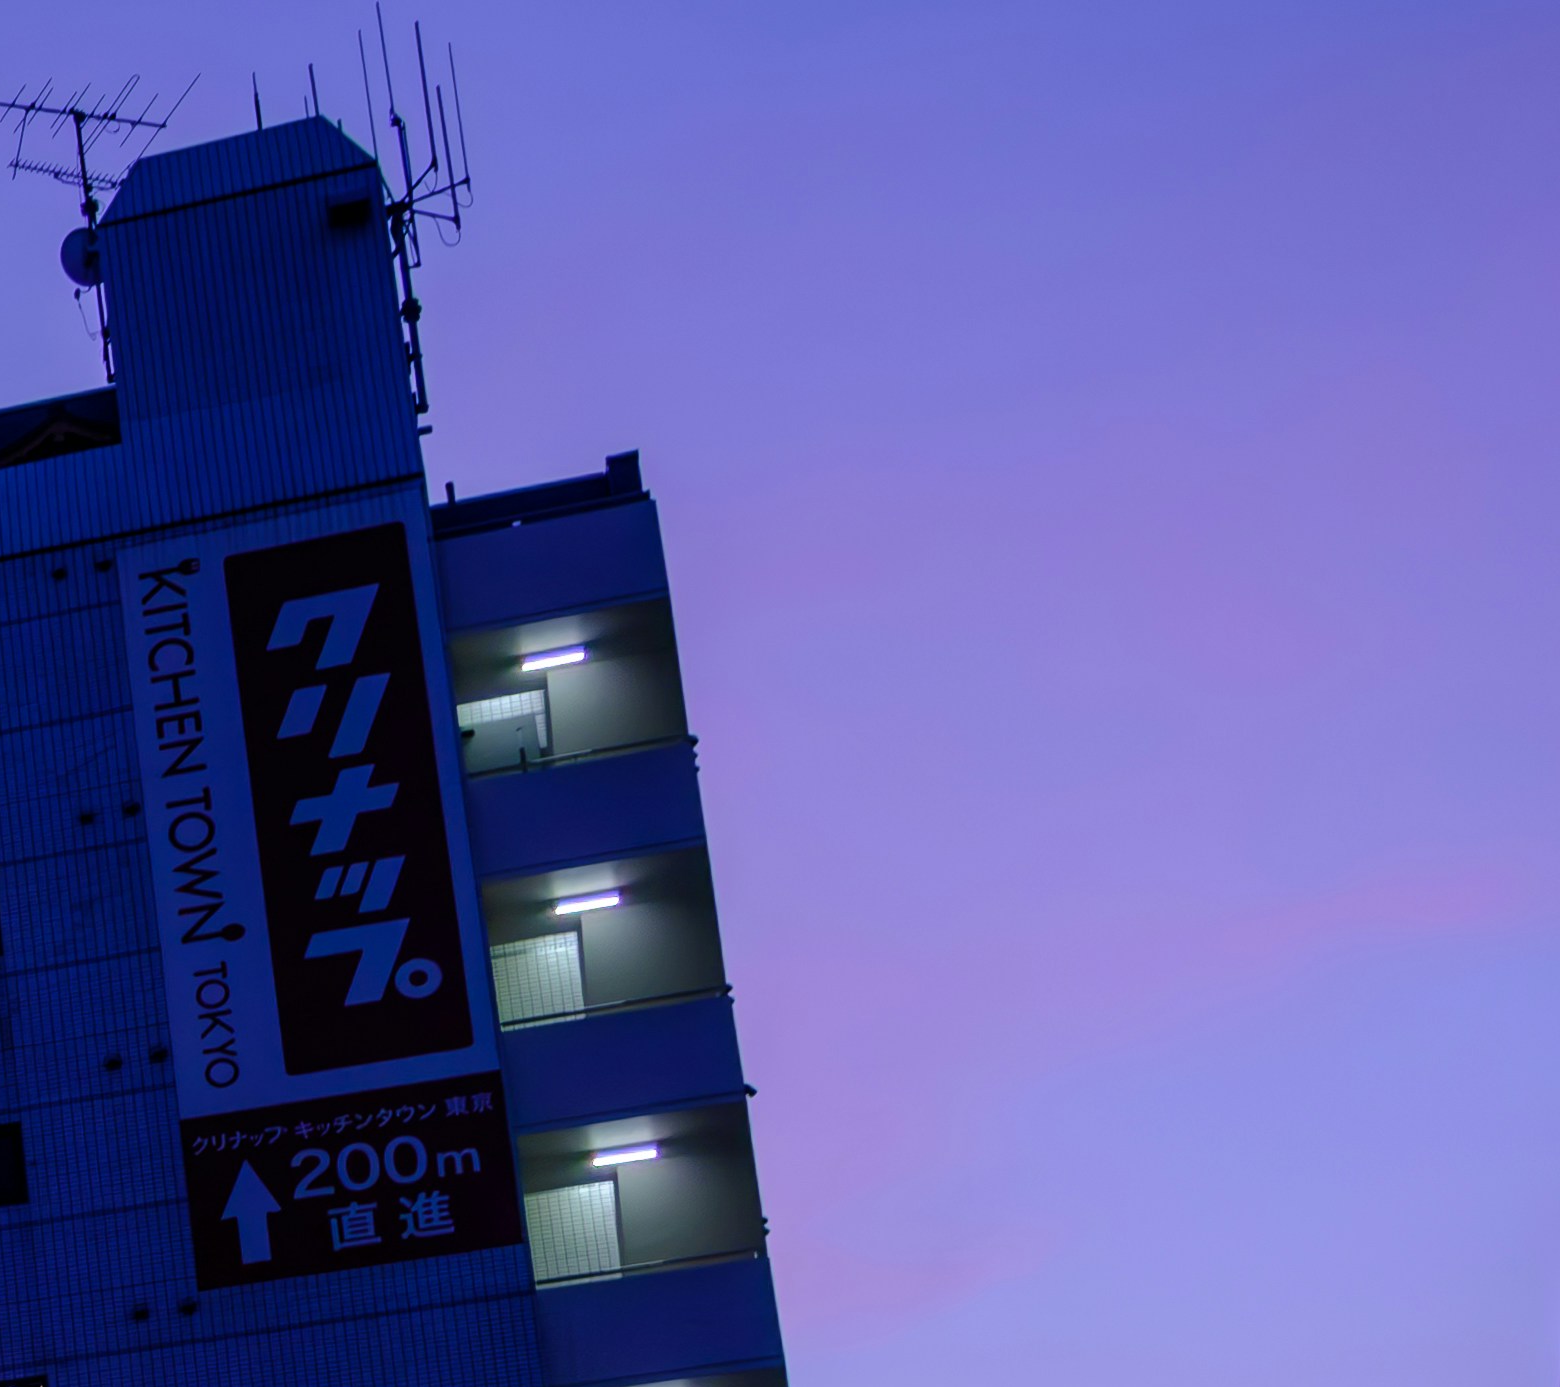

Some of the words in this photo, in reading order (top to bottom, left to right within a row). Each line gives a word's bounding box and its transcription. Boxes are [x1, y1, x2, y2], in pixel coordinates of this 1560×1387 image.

[138, 558, 207, 778] KITCHEN
[265, 581, 444, 1008] クリナップ
[165, 786, 246, 944] TOWN
[193, 961, 240, 1088] TOKYO
[191, 1124, 289, 1156] クリナップ
[293, 1103, 437, 1140] キッチンタウン
[443, 1091, 494, 1117] 東京
[289, 1134, 482, 1200] 200m
[326, 1189, 456, 1253] 直進
